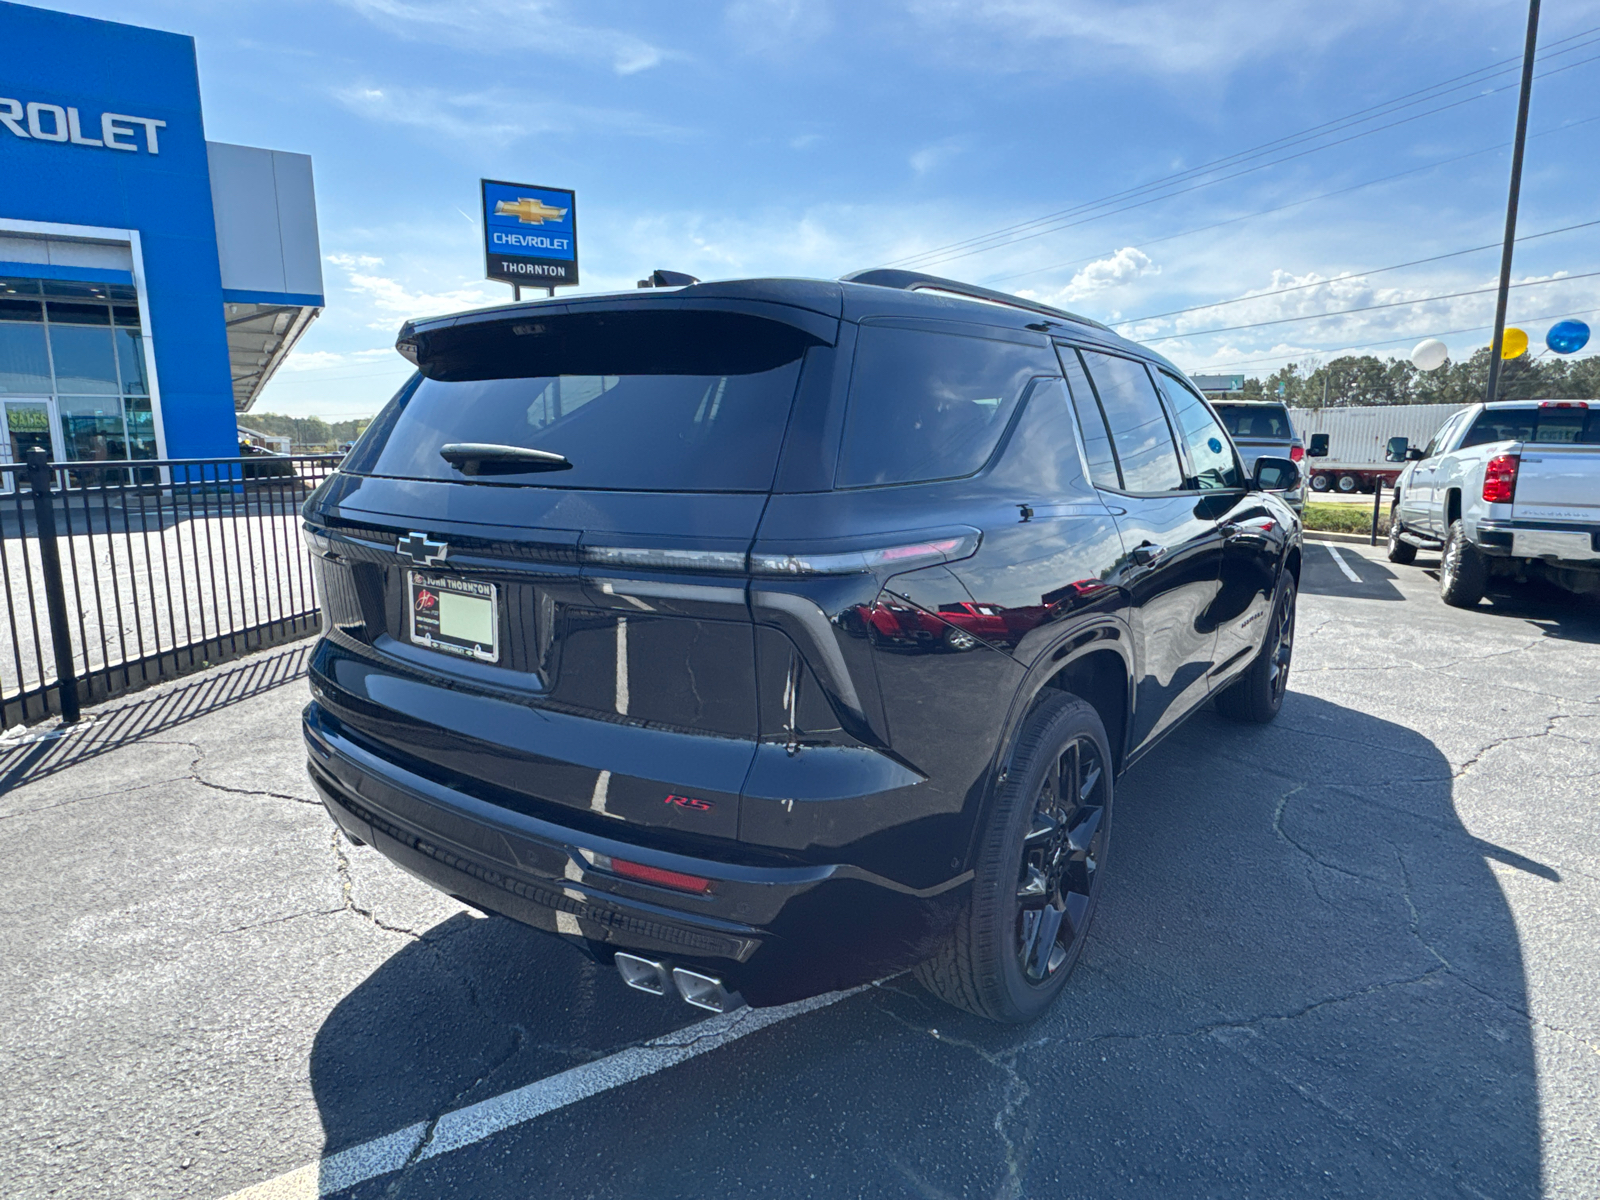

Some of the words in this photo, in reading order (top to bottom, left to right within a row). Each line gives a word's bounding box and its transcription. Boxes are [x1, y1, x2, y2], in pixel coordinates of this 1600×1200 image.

[0, 97, 167, 155] ROLET
[493, 232, 569, 250] CHEVROLET
[501, 262, 566, 277] THORNTON
[447, 579, 490, 595] THORNTON
[664, 794, 714, 811] RS
